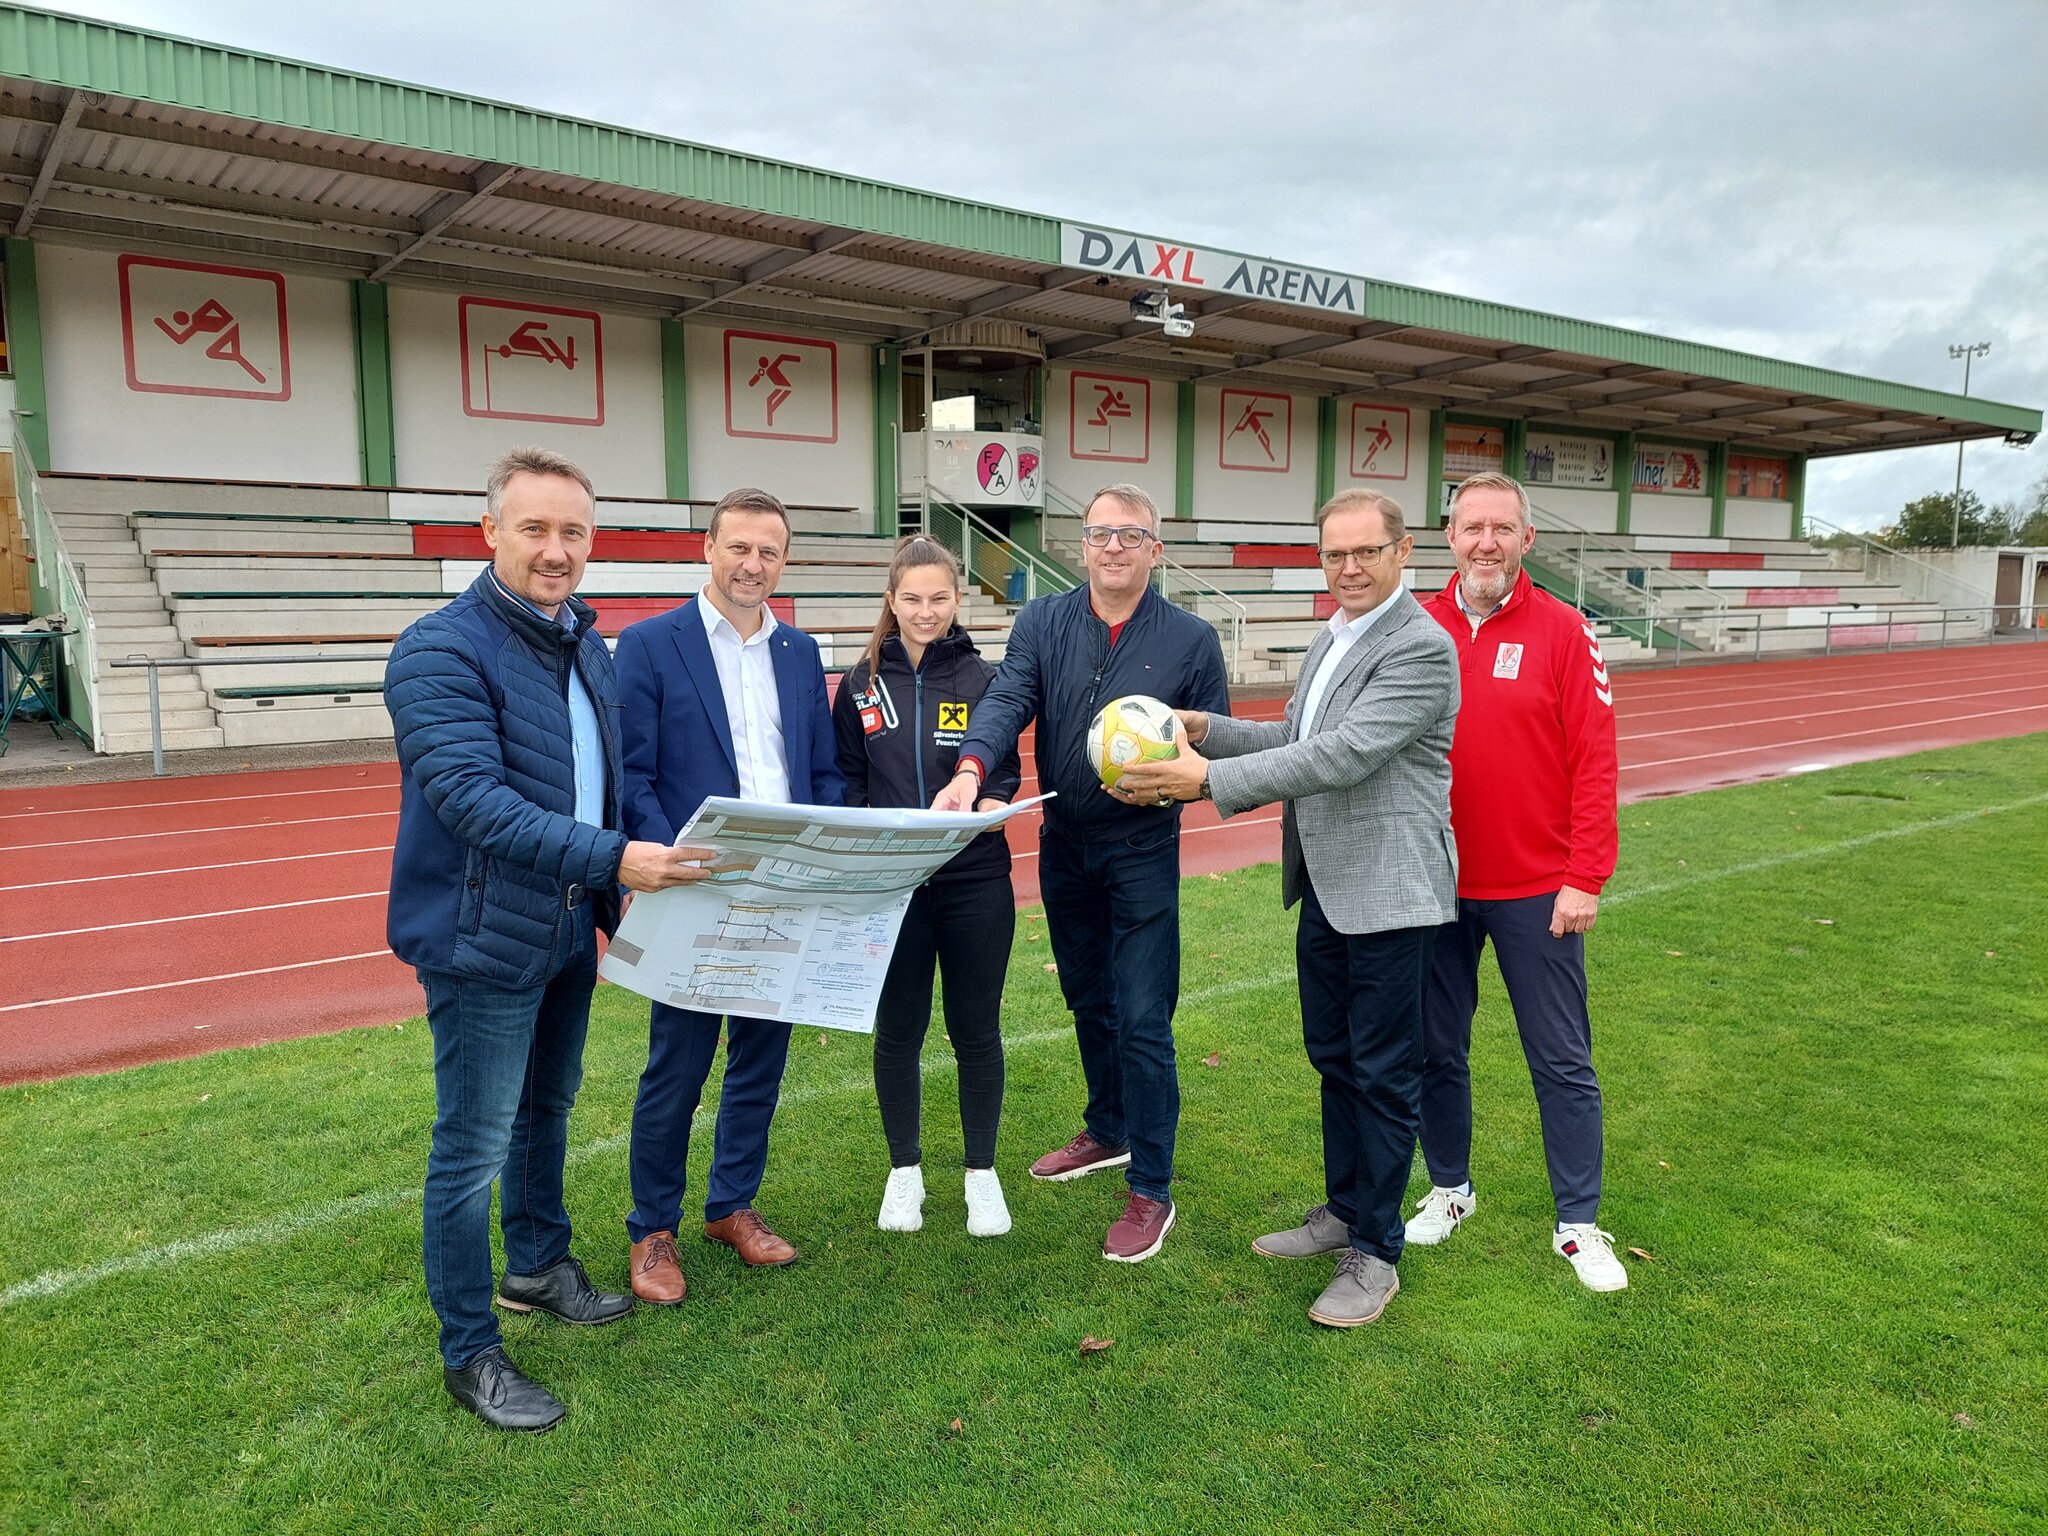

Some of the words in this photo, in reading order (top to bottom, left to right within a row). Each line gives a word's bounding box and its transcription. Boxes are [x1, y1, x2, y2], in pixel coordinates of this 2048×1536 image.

[1076, 228, 1204, 285] DAXL
[1222, 259, 1355, 311] ARENA
[936, 739, 960, 747] Peuerba
